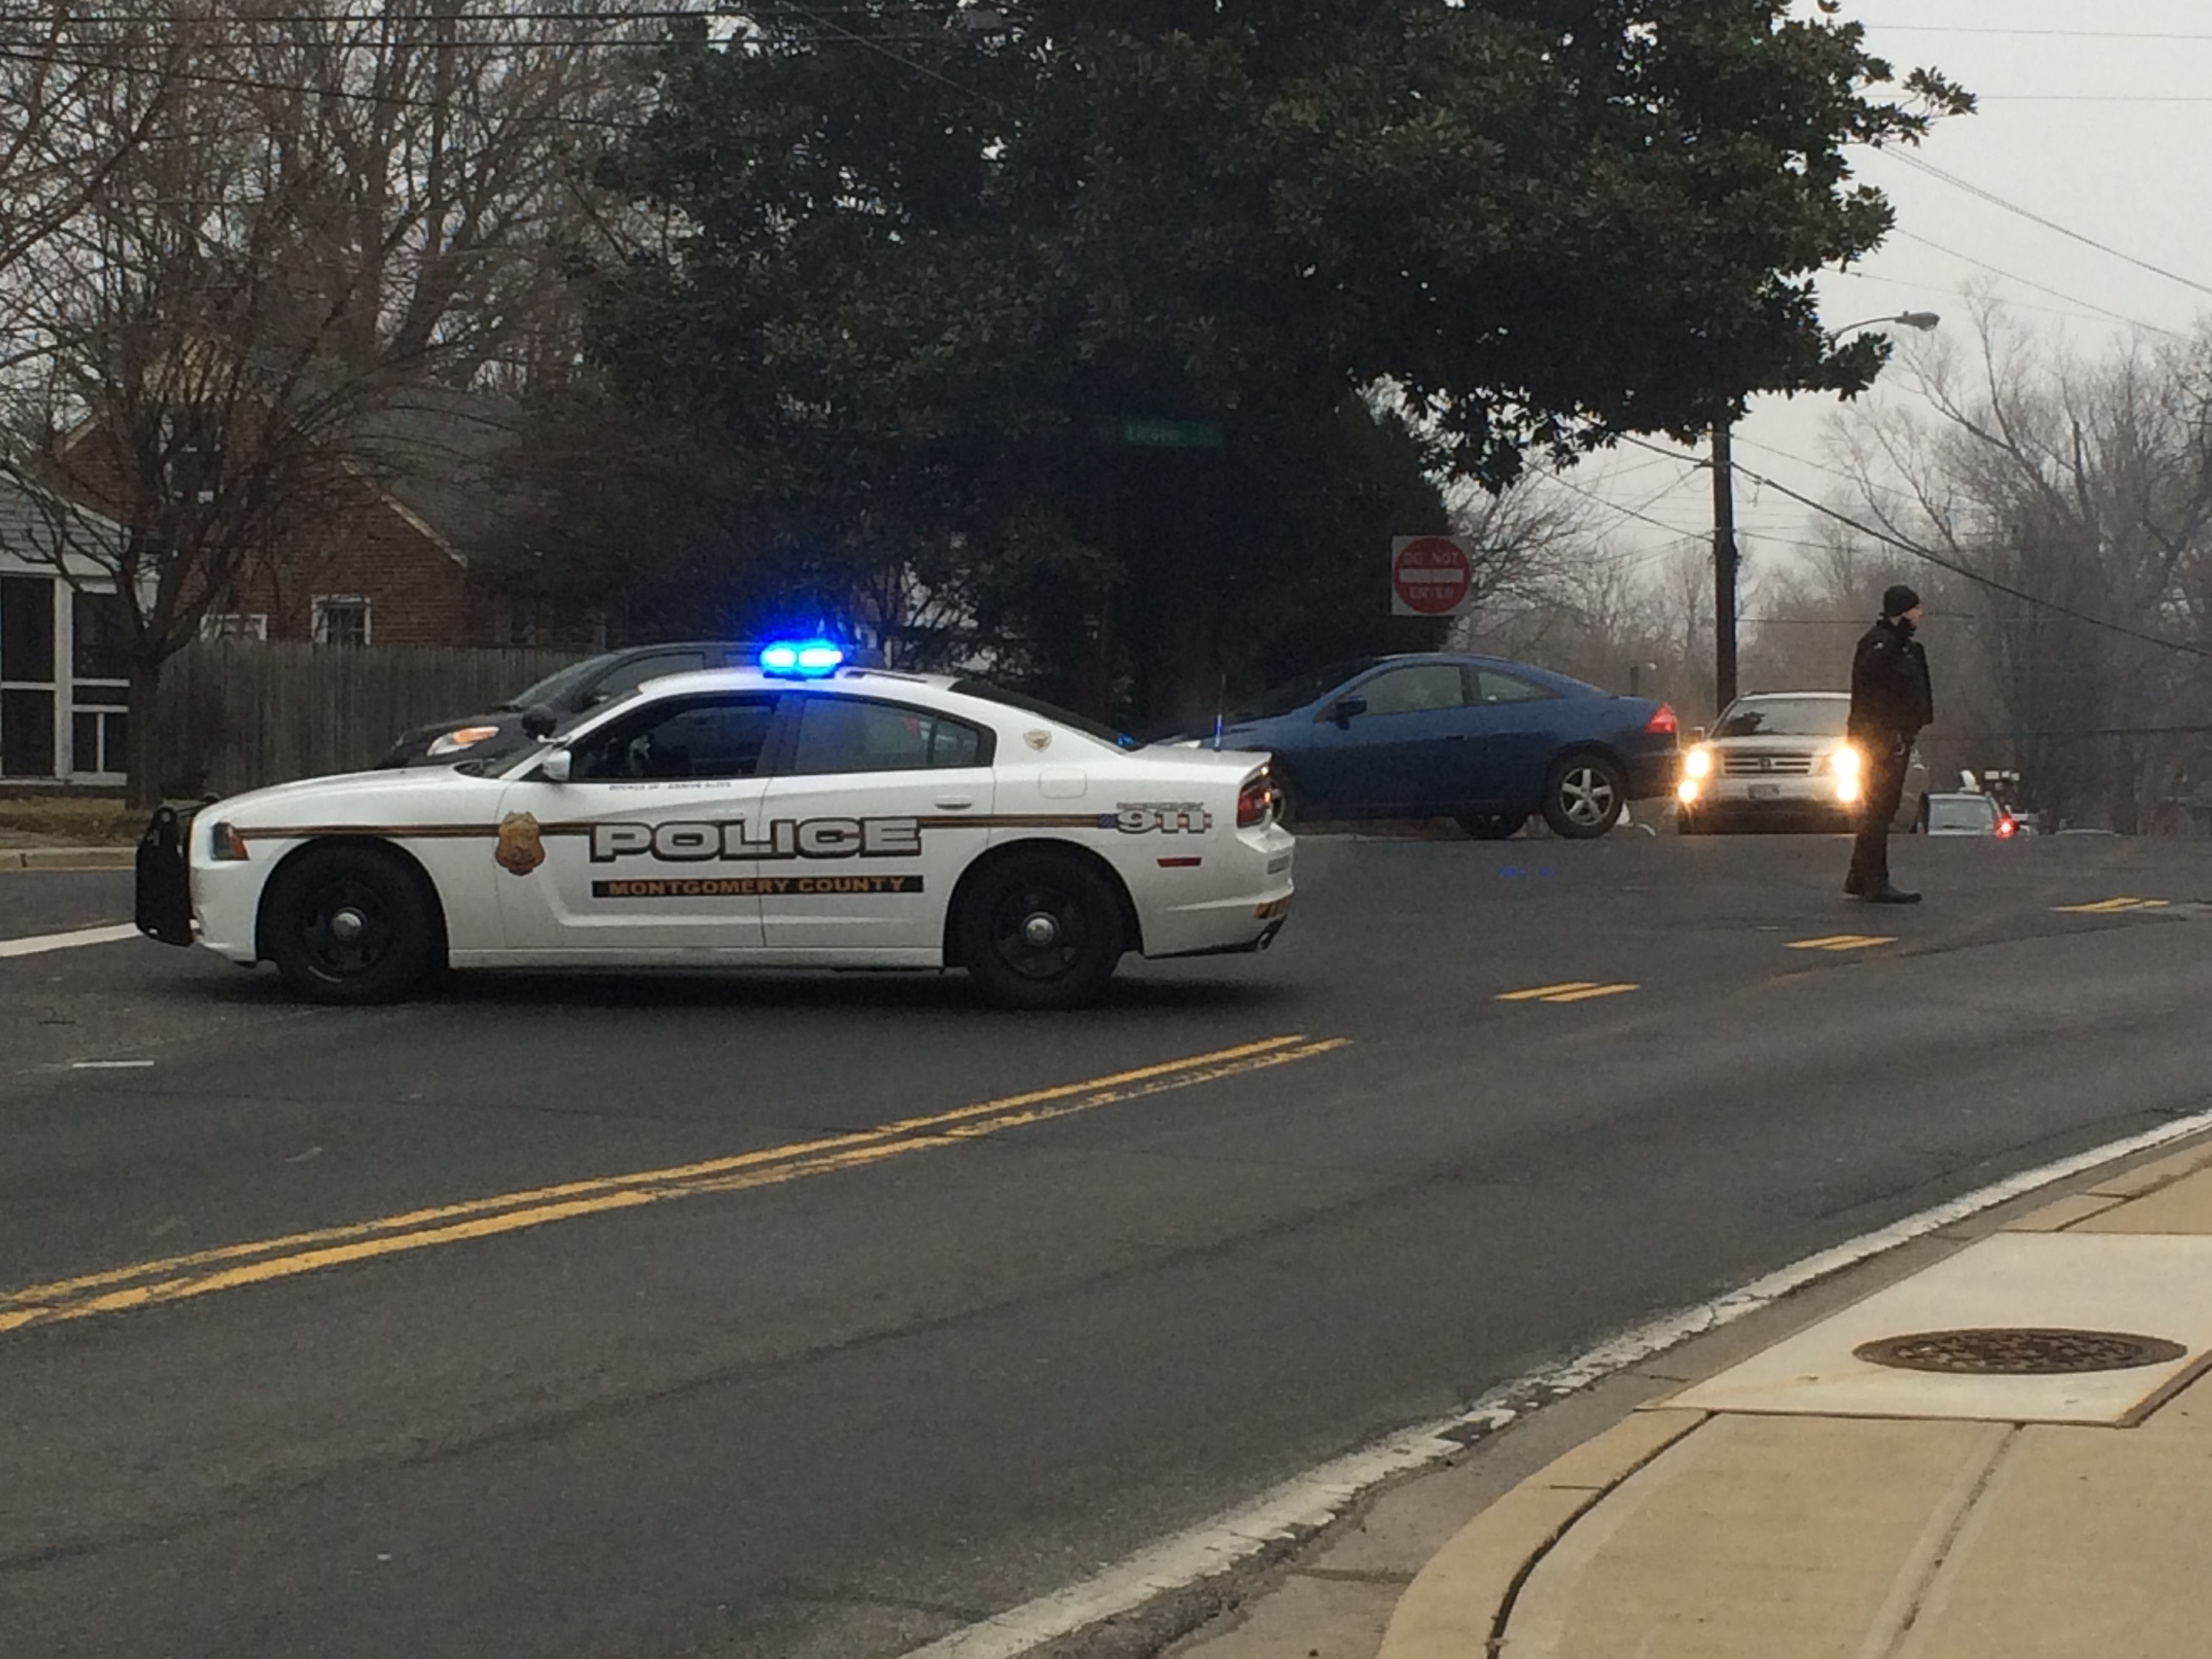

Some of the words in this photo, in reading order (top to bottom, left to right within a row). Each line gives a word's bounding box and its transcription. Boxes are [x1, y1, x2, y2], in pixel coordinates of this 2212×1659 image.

[1432, 552, 1459, 565] NOT
[1116, 810, 1205, 834] 911
[590, 816, 922, 862] POLICE
[608, 880, 789, 895] MONTGOMERY
[798, 877, 905, 892] COUNTY
